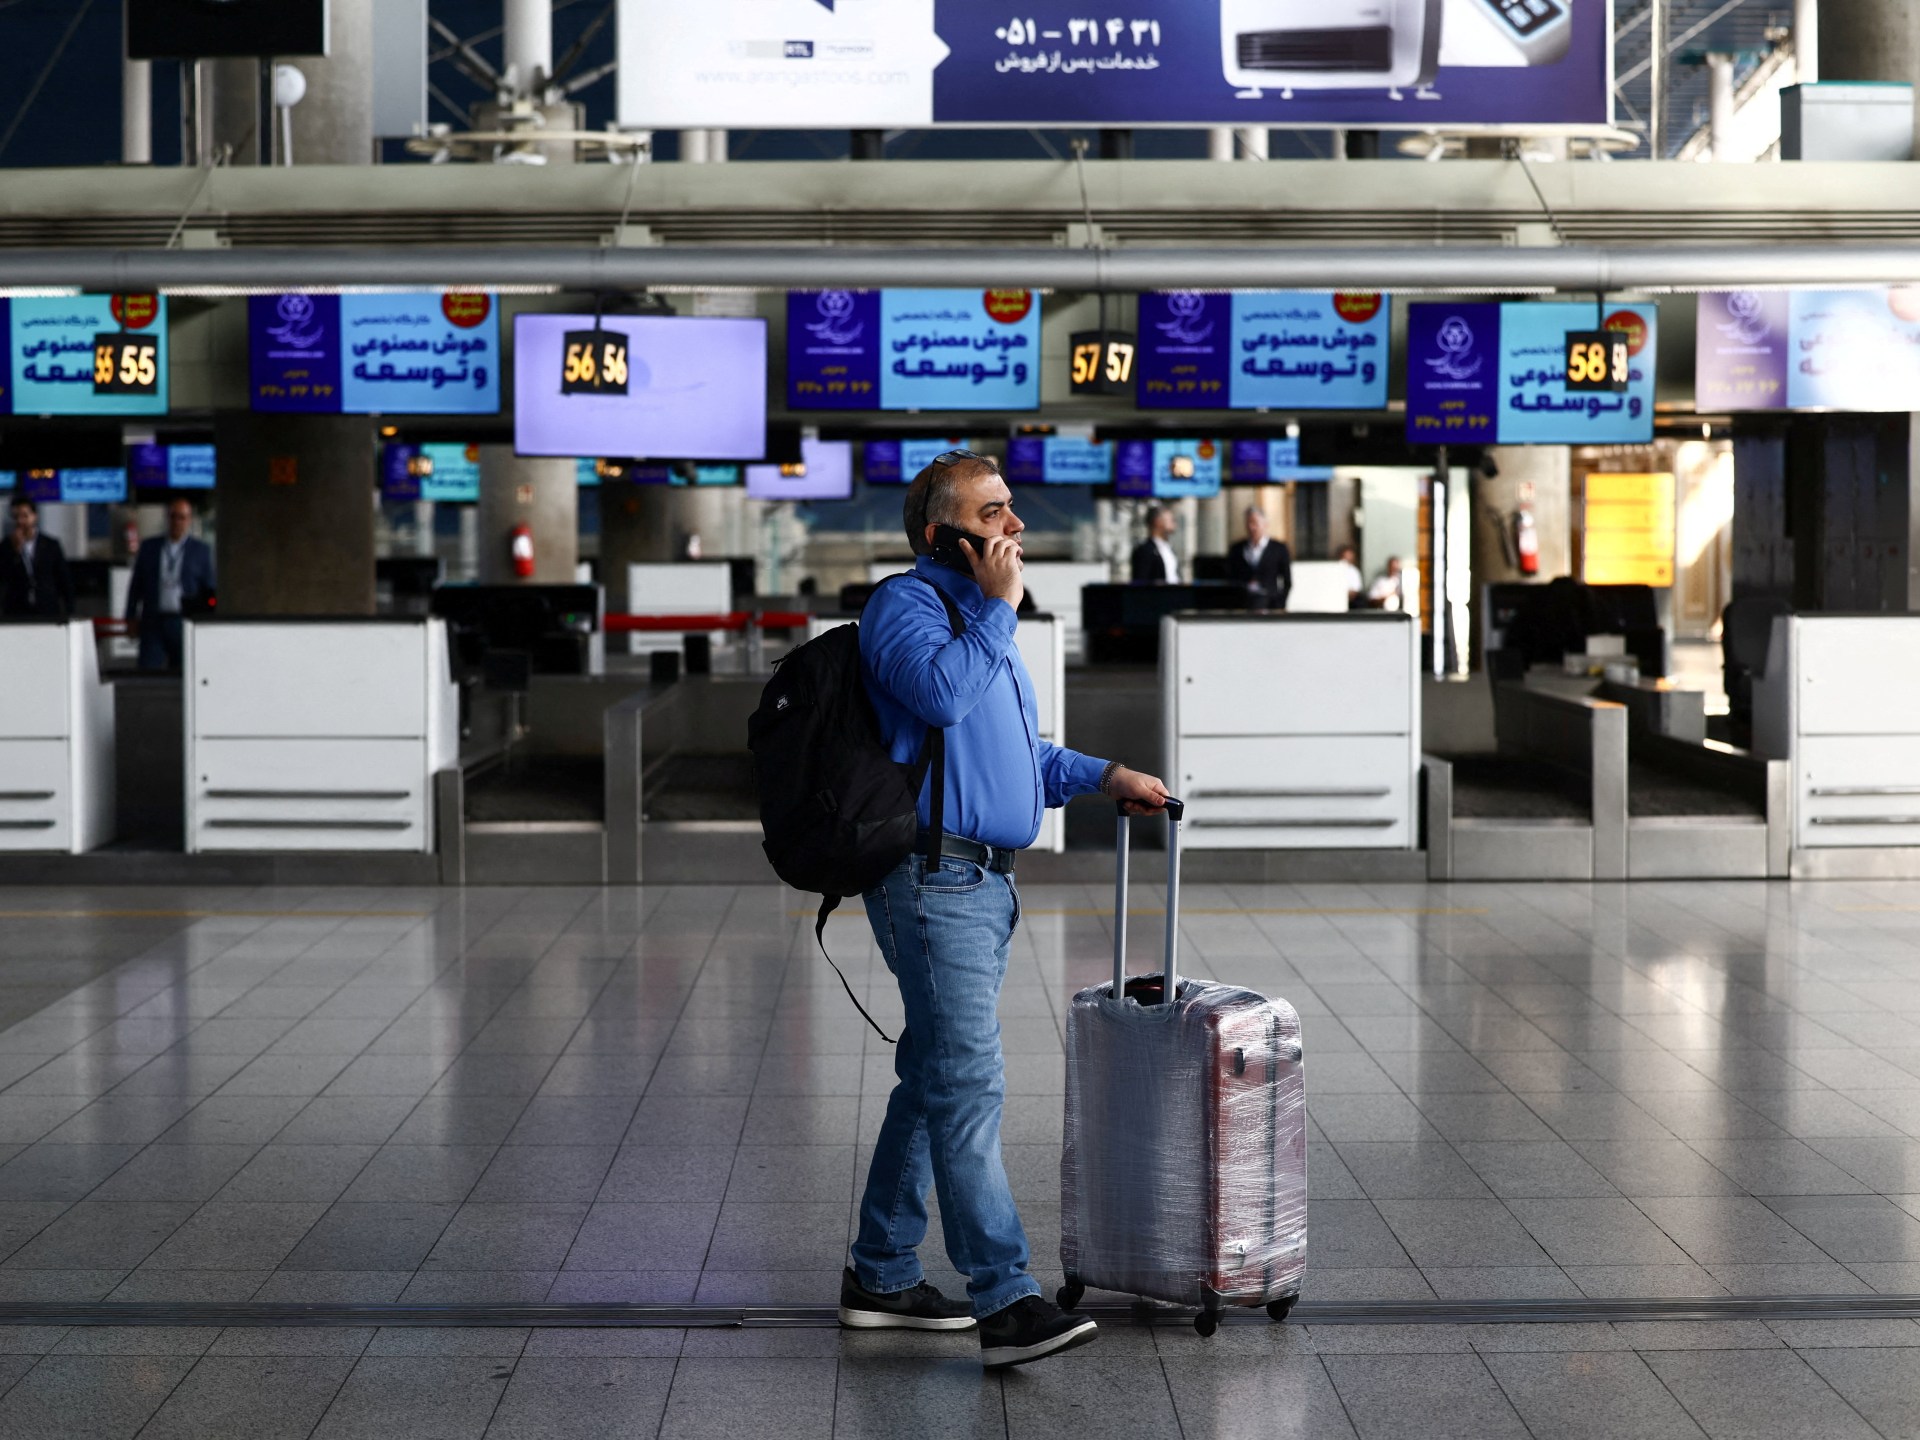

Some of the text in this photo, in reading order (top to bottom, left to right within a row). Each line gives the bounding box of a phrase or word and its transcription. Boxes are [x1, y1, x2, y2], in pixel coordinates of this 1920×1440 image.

[995, 17, 1036, 46] ۰۵۱
[995, 51, 1047, 73] فروش
[1062, 57, 1096, 74] پس
[1096, 51, 1160, 70] خدمات
[352, 333, 487, 357] هوش مصنوعی
[892, 329, 1028, 353] هوش مصنوعی
[1242, 328, 1377, 352] هوش مصنوعی
[94, 345, 114, 385] 55
[119, 345, 156, 386] 55
[564, 343, 596, 383] 56
[602, 343, 628, 385] 56
[1071, 343, 1101, 384] 57
[1105, 342, 1134, 382] 57
[1567, 343, 1606, 382] 58
[1611, 343, 1628, 383] 58
